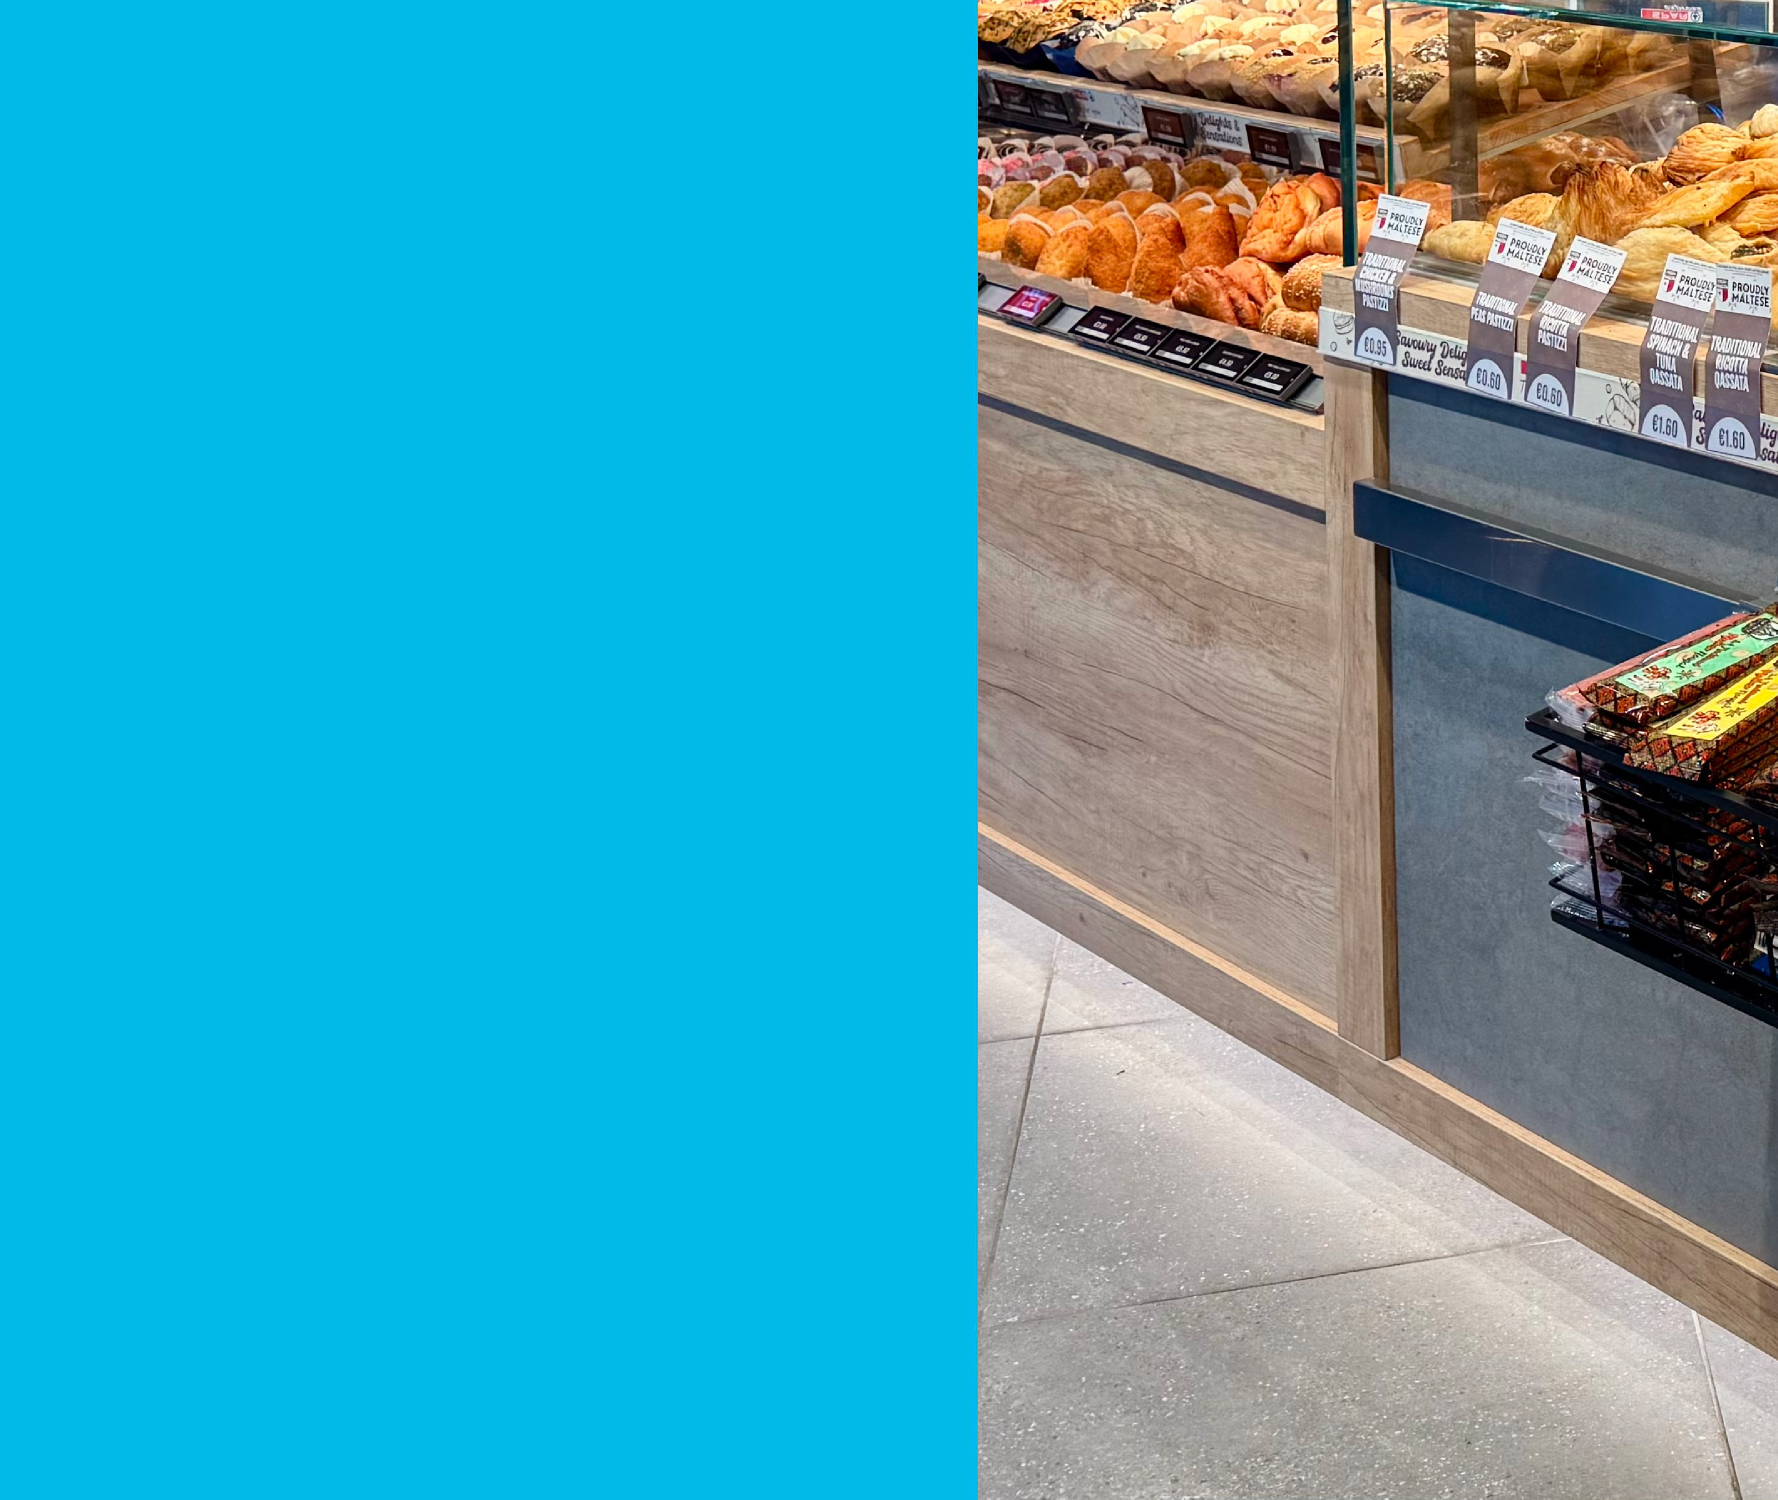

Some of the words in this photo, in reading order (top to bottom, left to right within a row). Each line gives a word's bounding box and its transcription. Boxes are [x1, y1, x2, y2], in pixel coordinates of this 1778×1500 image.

[1387, 221, 1422, 236] MALTESE
[1390, 212, 1424, 227] PROUDLY
[1732, 281, 1769, 296] PROUDLY
[1475, 291, 1518, 316] TRADITIONAL
[1731, 291, 1769, 308] MALTESE
[1471, 307, 1487, 324] PEAS
[1364, 337, 1387, 357] €0.95
[1711, 335, 1762, 359] TRADITIONAL
[1402, 351, 1432, 371] Sweet
[1715, 354, 1748, 374] RICOTTA
[1476, 372, 1501, 391] €0.60
[1714, 371, 1749, 392] QASSATA
[1536, 382, 1563, 407] €0.60
[1652, 414, 1678, 438] €1.60
[1718, 428, 1745, 450] €1.60
